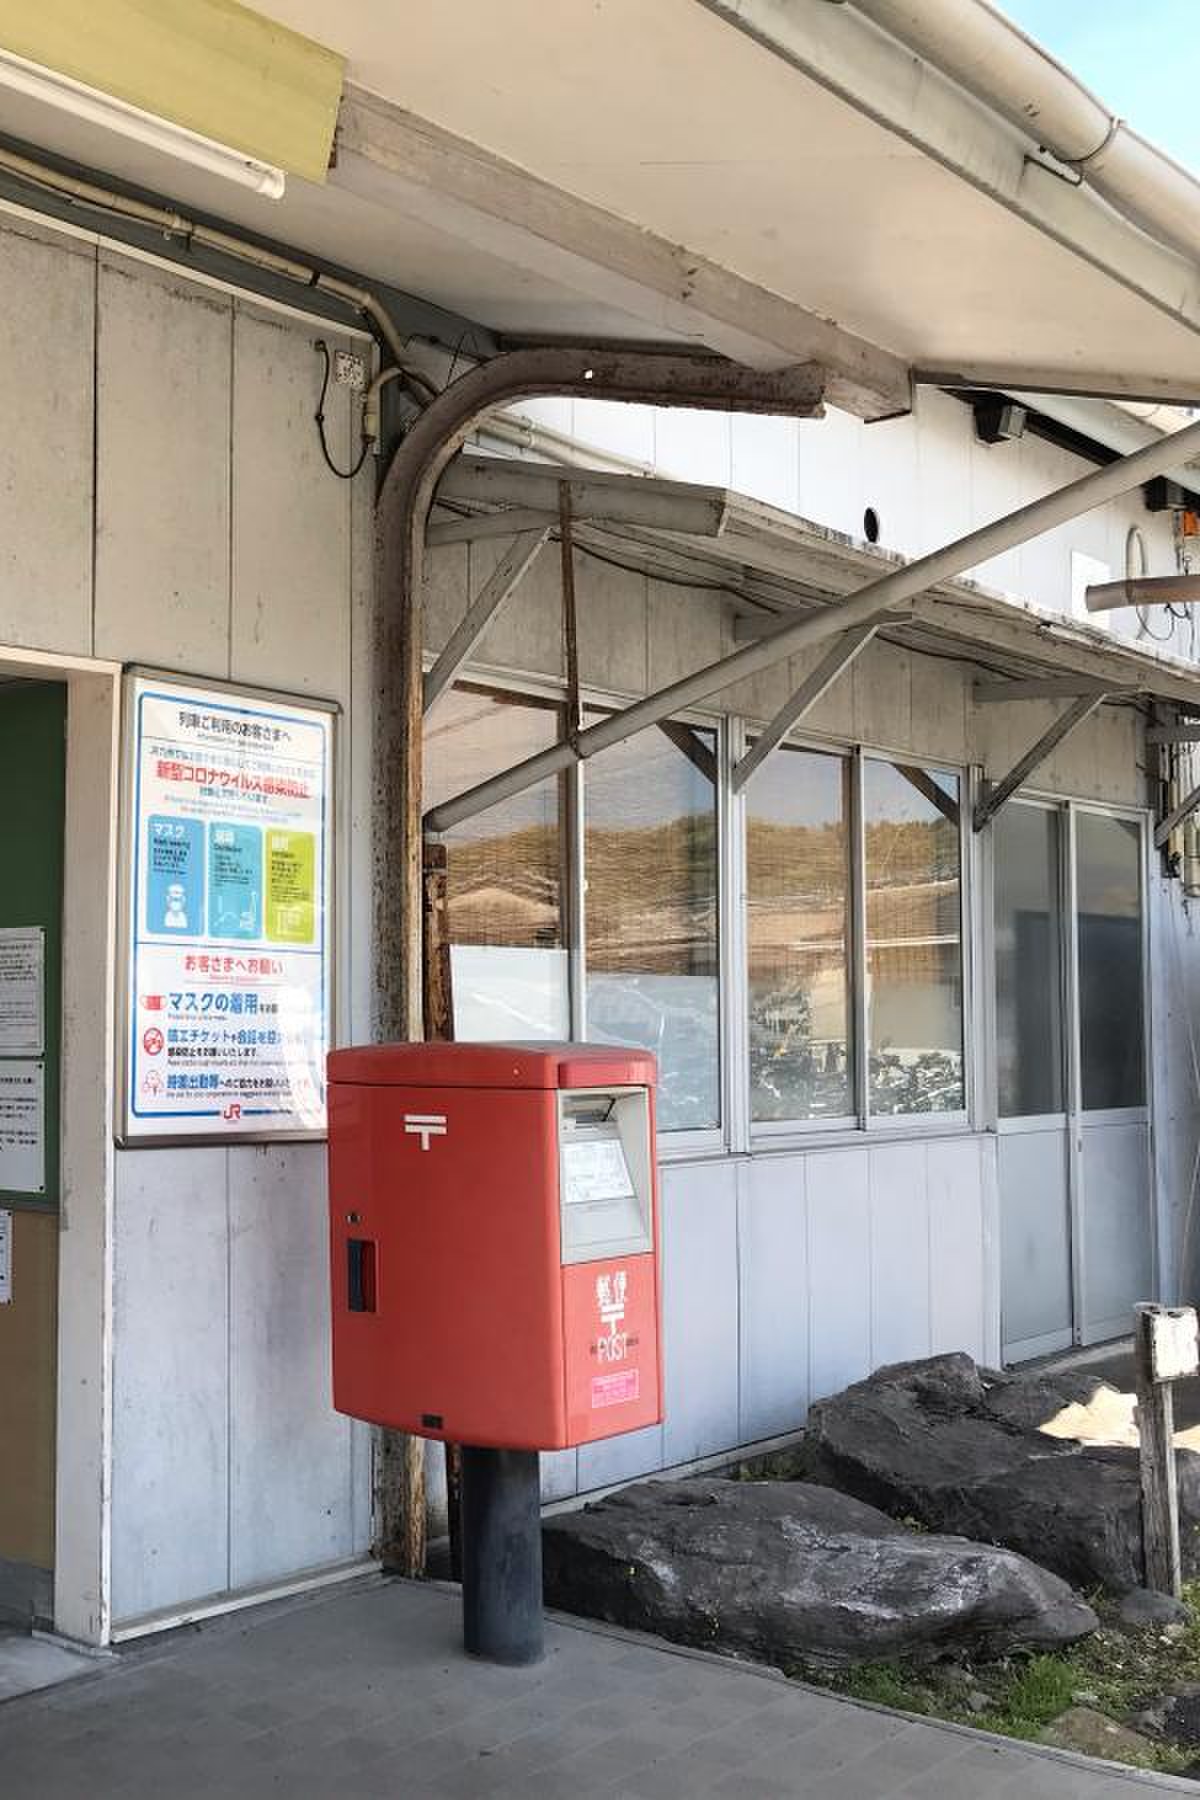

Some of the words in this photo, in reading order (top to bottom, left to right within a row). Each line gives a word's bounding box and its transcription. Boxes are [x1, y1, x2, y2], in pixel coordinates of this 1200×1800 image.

[185, 955, 284, 975] お客さまへお願い
[223, 1103, 241, 1120] JR
[597, 1332, 627, 1364] POST
